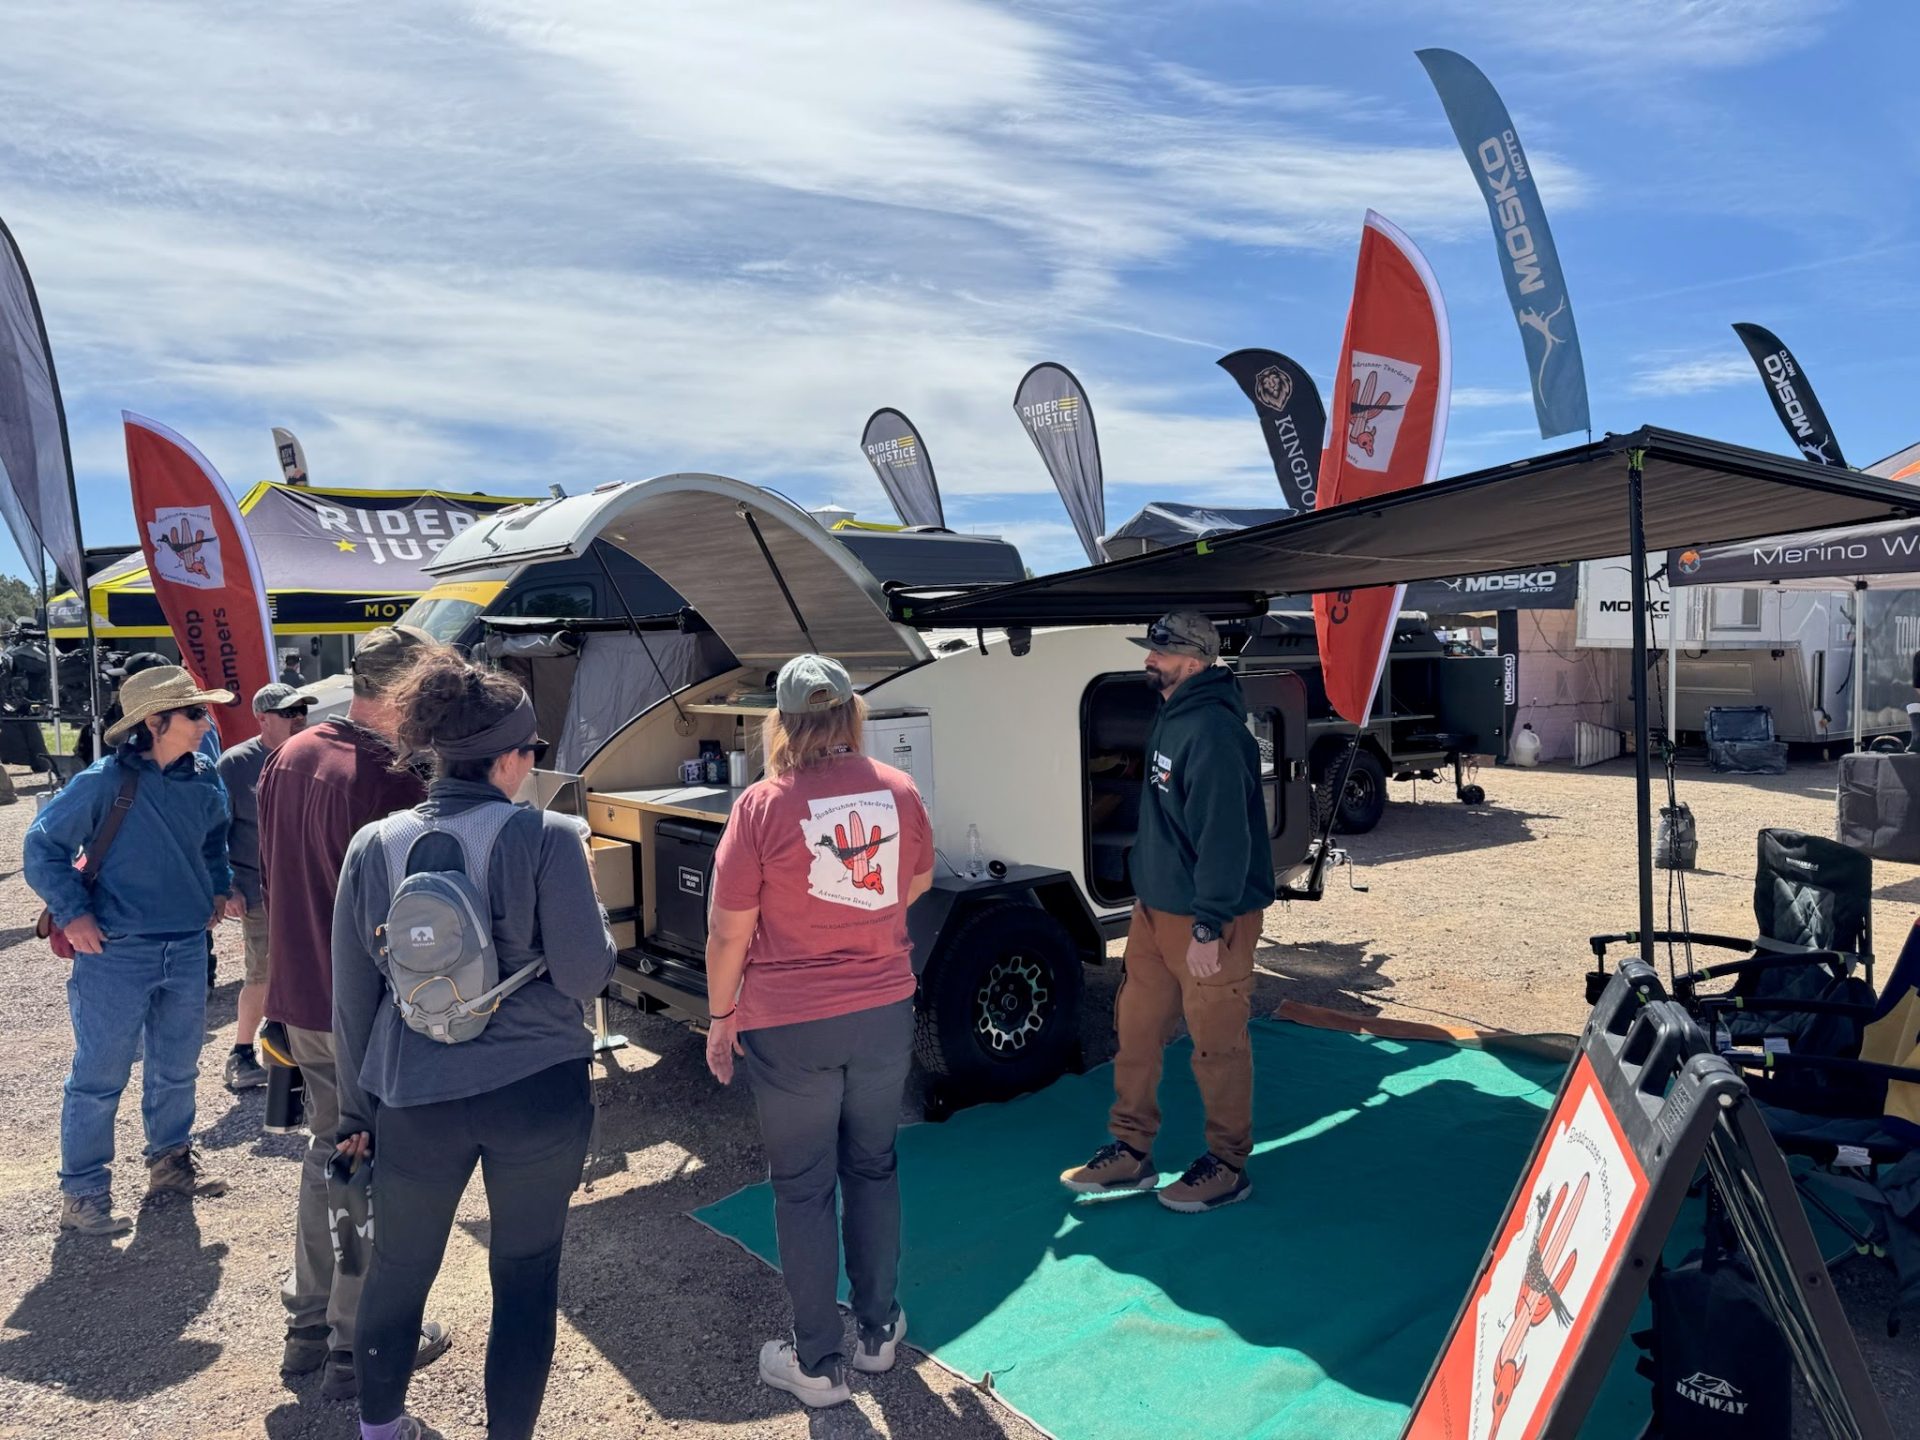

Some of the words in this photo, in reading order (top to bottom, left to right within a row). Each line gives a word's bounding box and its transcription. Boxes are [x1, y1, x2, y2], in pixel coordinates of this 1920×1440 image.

[1502, 129, 1527, 181] MOTO
[1478, 136, 1545, 296] MOSKO
[1779, 350, 1797, 377] MOTO
[1023, 400, 1058, 417] RIDER
[1763, 354, 1814, 438] MOSKO
[1033, 408, 1078, 431] JUSTICE
[867, 438, 899, 455] RIDER
[876, 446, 917, 466] JUSTICE
[1275, 414, 1317, 513] KINGDO
[1753, 542, 1868, 566] Merino
[1881, 534, 1920, 557] W
[1465, 570, 1557, 593] MOSKO
[1600, 600, 1670, 612] MOKO
[213, 606, 242, 708] Campers
[1504, 656, 1512, 702] MOSKO
[814, 802, 857, 821] Roadrunner
[859, 800, 894, 811] Teardrops
[818, 889, 852, 902] Adventure
[852, 897, 872, 908] Ready
